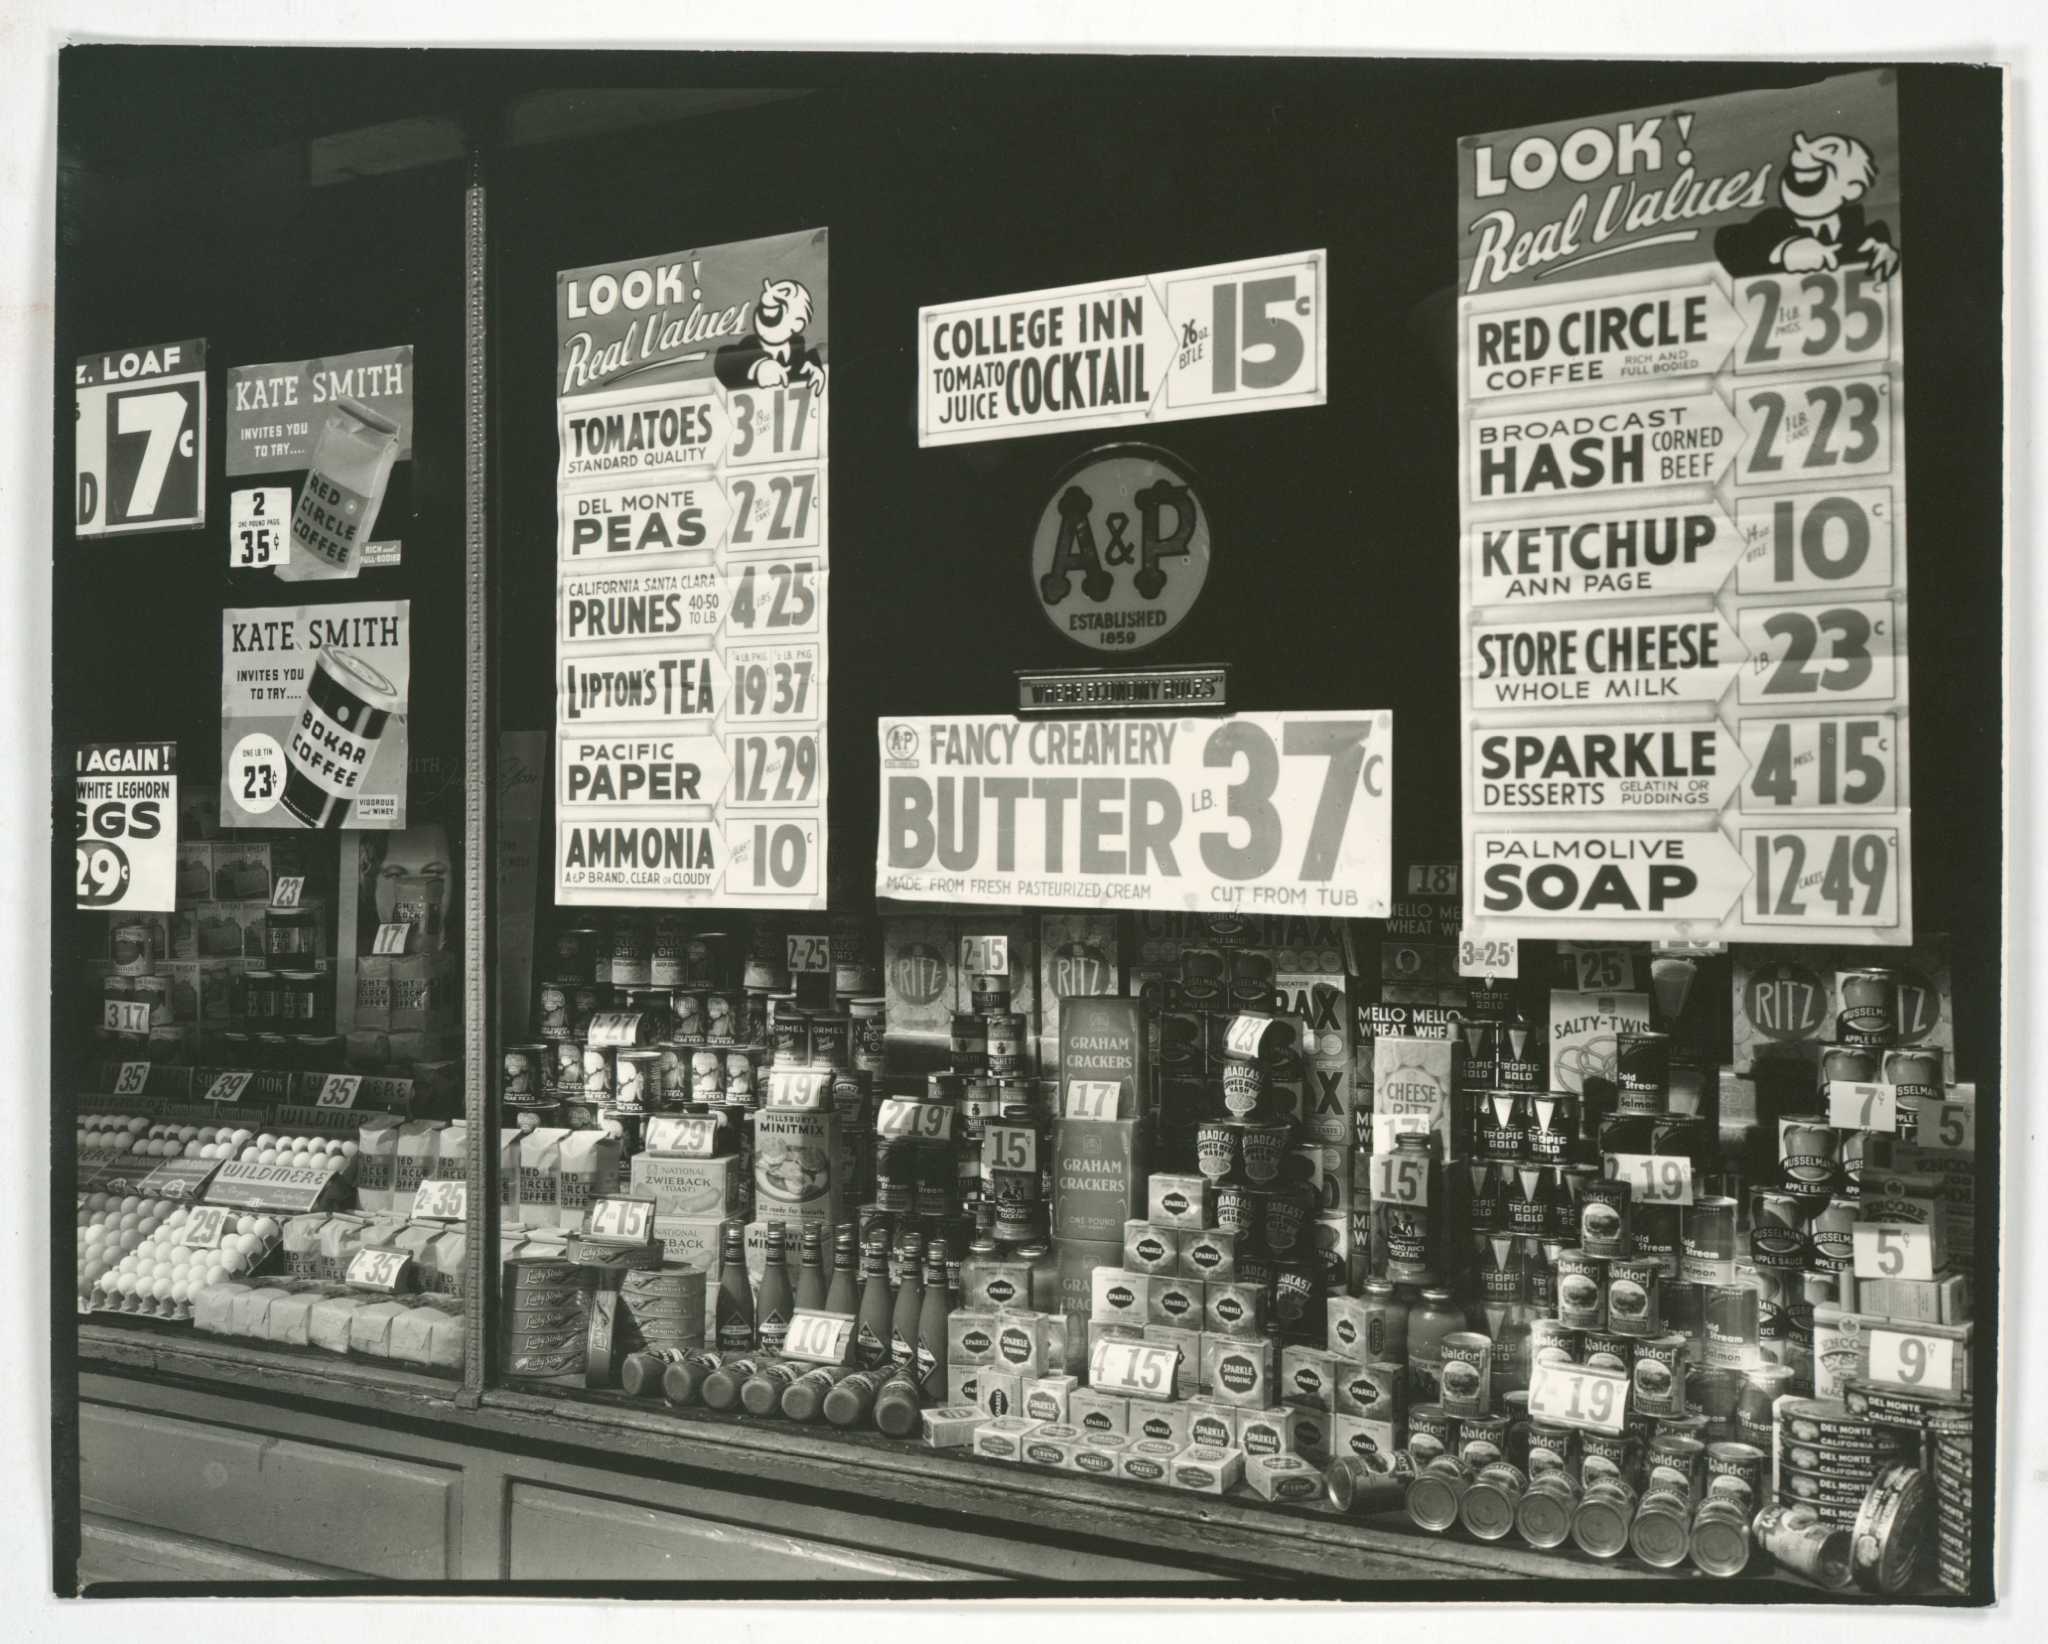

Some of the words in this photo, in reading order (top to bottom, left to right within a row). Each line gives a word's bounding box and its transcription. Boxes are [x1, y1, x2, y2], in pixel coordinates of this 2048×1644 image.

[1475, 113, 1695, 197] LOOK!
[1466, 194, 1589, 293] Real
[1594, 163, 1773, 239] Values
[568, 261, 702, 318] LOOK!
[934, 307, 1064, 360] COLLEGE
[1079, 296, 1143, 343] INN
[1477, 311, 1551, 367] RED
[1559, 296, 1707, 355] CIRCLE
[1744, 280, 1781, 364] 2
[103, 347, 181, 380] LOAF
[562, 321, 637, 394] Real
[641, 302, 749, 359] Values
[1180, 346, 1203, 370] BTLE
[1659, 350, 1689, 362] AND
[934, 361, 1005, 394] TOMATO
[1005, 343, 1149, 416] COCKTAIL
[1487, 360, 1604, 390] COFFEE
[1621, 366, 1649, 377] FULL
[1653, 359, 1699, 374] BODIED
[236, 376, 299, 411] KATE
[312, 363, 404, 403] SMITH
[939, 392, 997, 423] JUICE
[241, 425, 282, 441] INVITES
[287, 422, 308, 436] YOU
[569, 404, 712, 457] TOMATOES
[733, 394, 754, 457] 3
[1479, 407, 1687, 444] BROADCAST
[1652, 427, 1722, 451] CORNED
[1747, 391, 1785, 473] 2
[255, 444, 272, 457] TO
[568, 455, 637, 473] STANDARD
[645, 447, 706, 466] QUALITY
[1480, 434, 1644, 496] HASH
[1660, 452, 1714, 480] BEEF
[253, 492, 265, 515] 2
[309, 474, 341, 506] RED
[579, 498, 612, 515] DEL
[622, 491, 694, 511] MONTE
[301, 496, 357, 541] CIRCLE
[731, 480, 755, 544] 2
[293, 519, 349, 562] COFFEE
[572, 508, 706, 555] PEAS
[1041, 479, 1196, 605] A&P
[1482, 514, 1716, 577] KETCHUP
[569, 580, 638, 597] CALIFORNIA
[644, 576, 677, 591] SANTA
[681, 574, 716, 588] CLARA
[731, 566, 755, 629] 4
[1506, 578, 1570, 598] ANN
[1584, 572, 1652, 592] PAGE
[569, 593, 682, 637] PRUNES
[689, 611, 701, 624] TO
[1070, 610, 1166, 630] ESTABLISHED
[232, 622, 294, 652] KATE
[309, 616, 398, 649] SMITH
[1100, 632, 1135, 644] 1859
[1478, 630, 1577, 679] STORE
[1585, 622, 1719, 675] CHEESE
[236, 669, 279, 682] INVITES
[284, 668, 304, 681] YOU
[658, 657, 715, 715] TEA
[1495, 681, 1590, 701] WHOLE
[1606, 677, 1679, 697] MILK
[250, 688, 264, 700] TO
[302, 710, 366, 765] BOKAR
[580, 743, 674, 761] PACIFIC
[930, 723, 1019, 765] FANCY
[1029, 723, 1178, 765] CREAMERY
[86, 746, 169, 772] AGAIN!
[292, 734, 358, 788] COFFEE
[735, 737, 767, 801] 12
[1481, 731, 1716, 779] SPARKLE
[1750, 724, 1796, 805] 4
[77, 781, 112, 799] WHITE
[117, 781, 169, 798] LEGHORN
[569, 763, 701, 801] PAPER
[1484, 783, 1604, 806] DESSERTS
[1621, 781, 1679, 792] GELATIN
[1687, 780, 1709, 790] OR
[1621, 792, 1709, 804] PUDDINGS
[888, 776, 1183, 877] BUTTER
[566, 828, 715, 869] AMMONIA
[1486, 840, 1684, 859] PALMOLIVE
[631, 873, 660, 884] CLEAR
[673, 872, 711, 885] CLOUDY
[887, 876, 921, 892] MADE
[930, 878, 964, 893] FROM
[970, 880, 1011, 895] FRESH
[1018, 880, 1100, 898] PASTEURIZED
[1106, 883, 1151, 900] CREAM
[1483, 864, 1698, 912] SOAP
[1755, 835, 1806, 916] 12
[1211, 886, 1244, 904] CUT
[1253, 886, 1307, 904] FROM
[1317, 889, 1358, 906] TUB
[900, 959, 943, 997] RITZ
[1057, 957, 1100, 995] RITZ
[1755, 980, 1815, 1030] RITZ
[1071, 1036, 1129, 1050] GRAHAM
[1067, 1055, 1133, 1069] CRACKERS
[1387, 1083, 1437, 1102] CHEESE
[760, 1123, 824, 1135] MINITMIX
[223, 1163, 332, 1185] WILDMERE
[1063, 1158, 1122, 1173] GRAHAM
[645, 1176, 711, 1187] ZWIEBACK
[1060, 1177, 1125, 1192] CRACKERS
[1222, 1362, 1254, 1376] SPARKLE
[1869, 1396, 1886, 1408] DEL
[1887, 1399, 1921, 1413] MONTE
[1820, 1423, 1837, 1433] DEL
[1840, 1426, 1872, 1436] MONTE
[1820, 1437, 1874, 1449] CALIFORNIA
